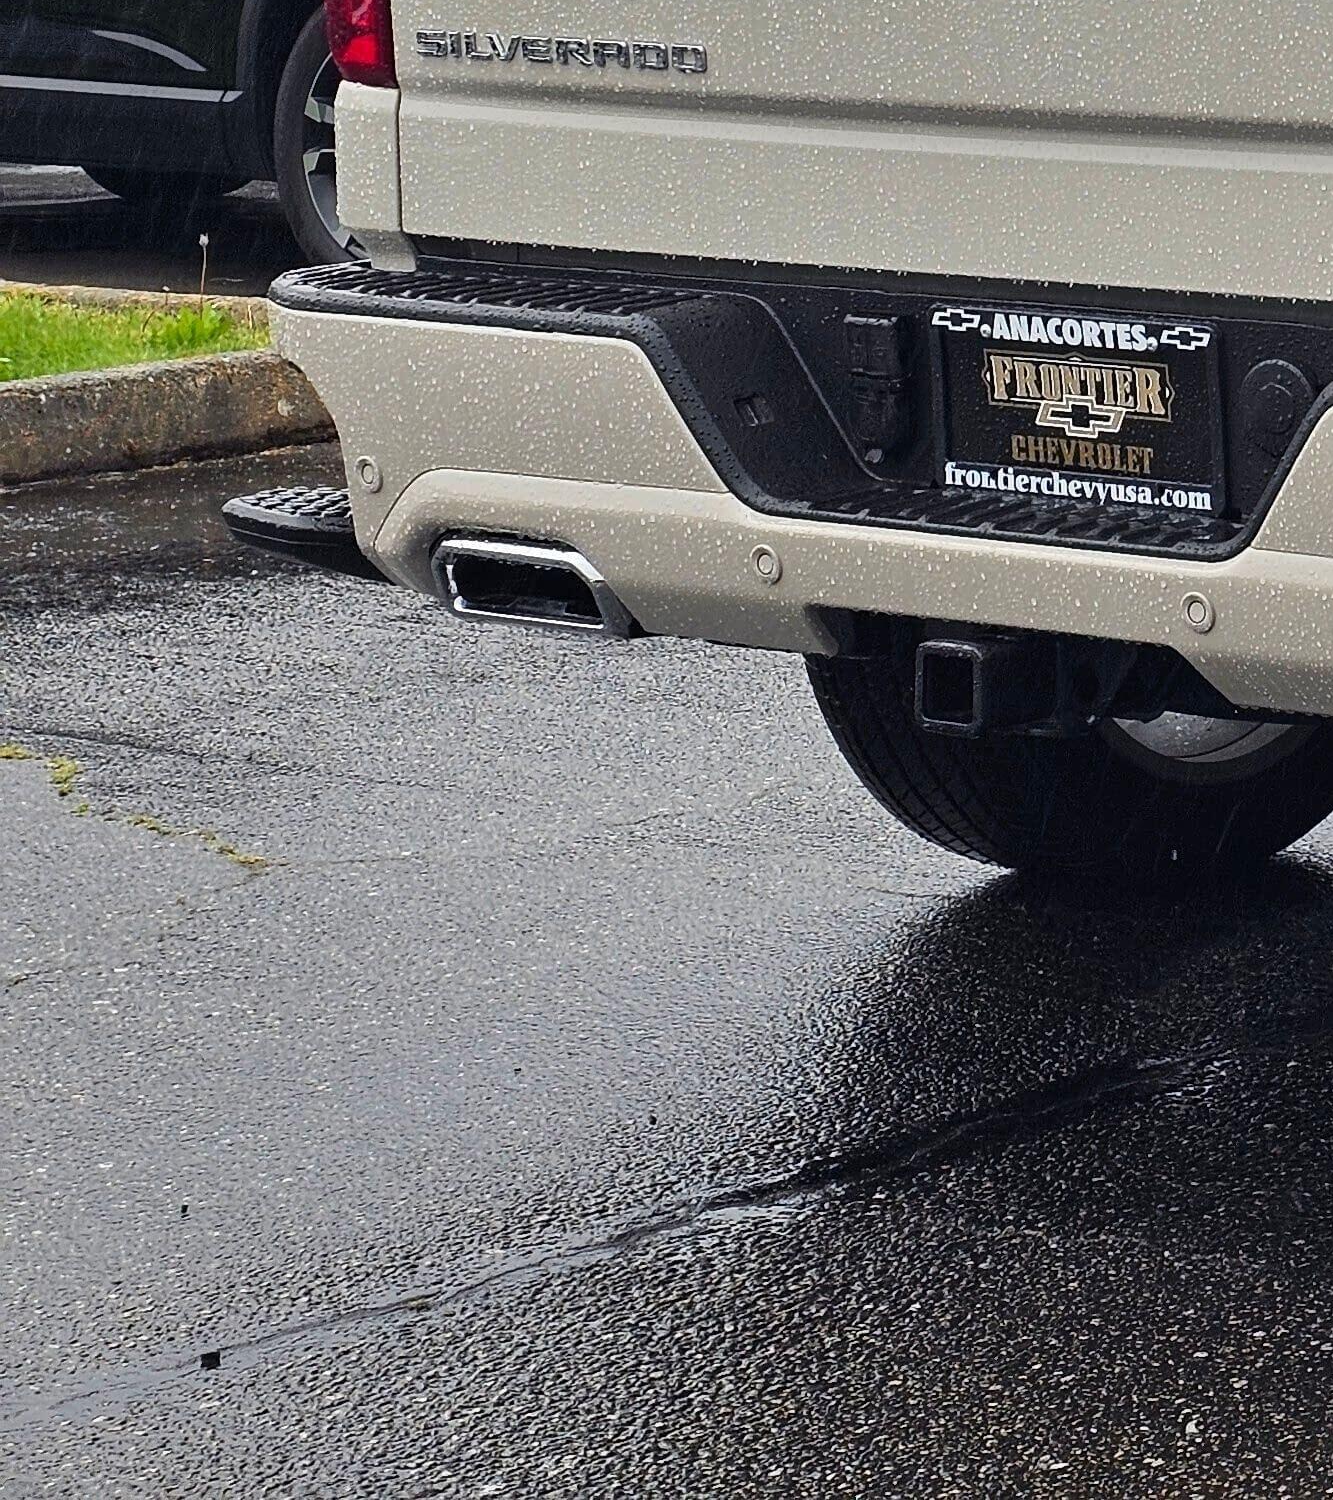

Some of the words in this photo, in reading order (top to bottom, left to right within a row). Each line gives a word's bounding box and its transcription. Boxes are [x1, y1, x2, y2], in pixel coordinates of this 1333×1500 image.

[415, 29, 708, 73] SILVERADO
[992, 313, 1149, 352] ANACORTES
[989, 354, 1167, 417] FRONTIER
[1010, 434, 1154, 474] CHEVROLET
